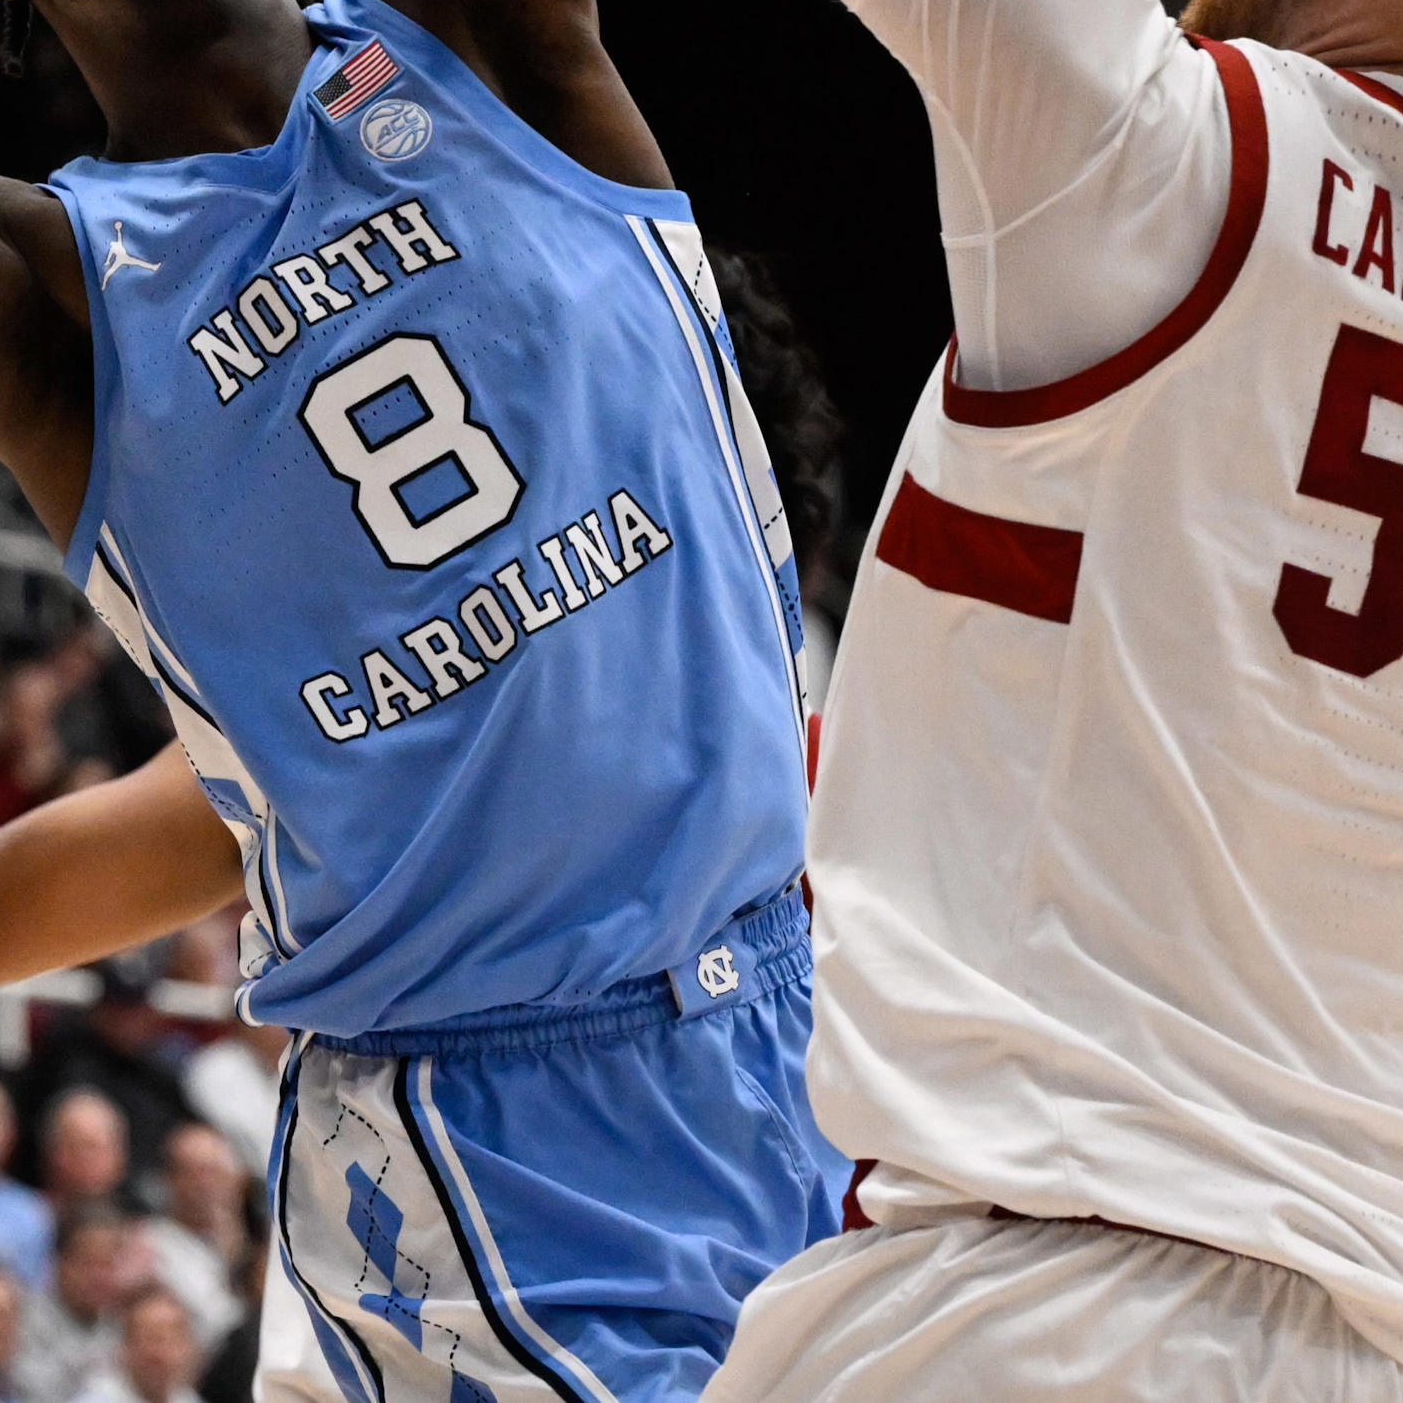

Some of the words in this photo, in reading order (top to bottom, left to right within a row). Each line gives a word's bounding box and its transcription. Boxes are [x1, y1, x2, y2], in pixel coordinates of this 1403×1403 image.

[377, 105, 419, 144] ACC
[190, 199, 459, 403] NORTH
[298, 332, 525, 570] 8
[301, 488, 672, 743] CAROLINA
